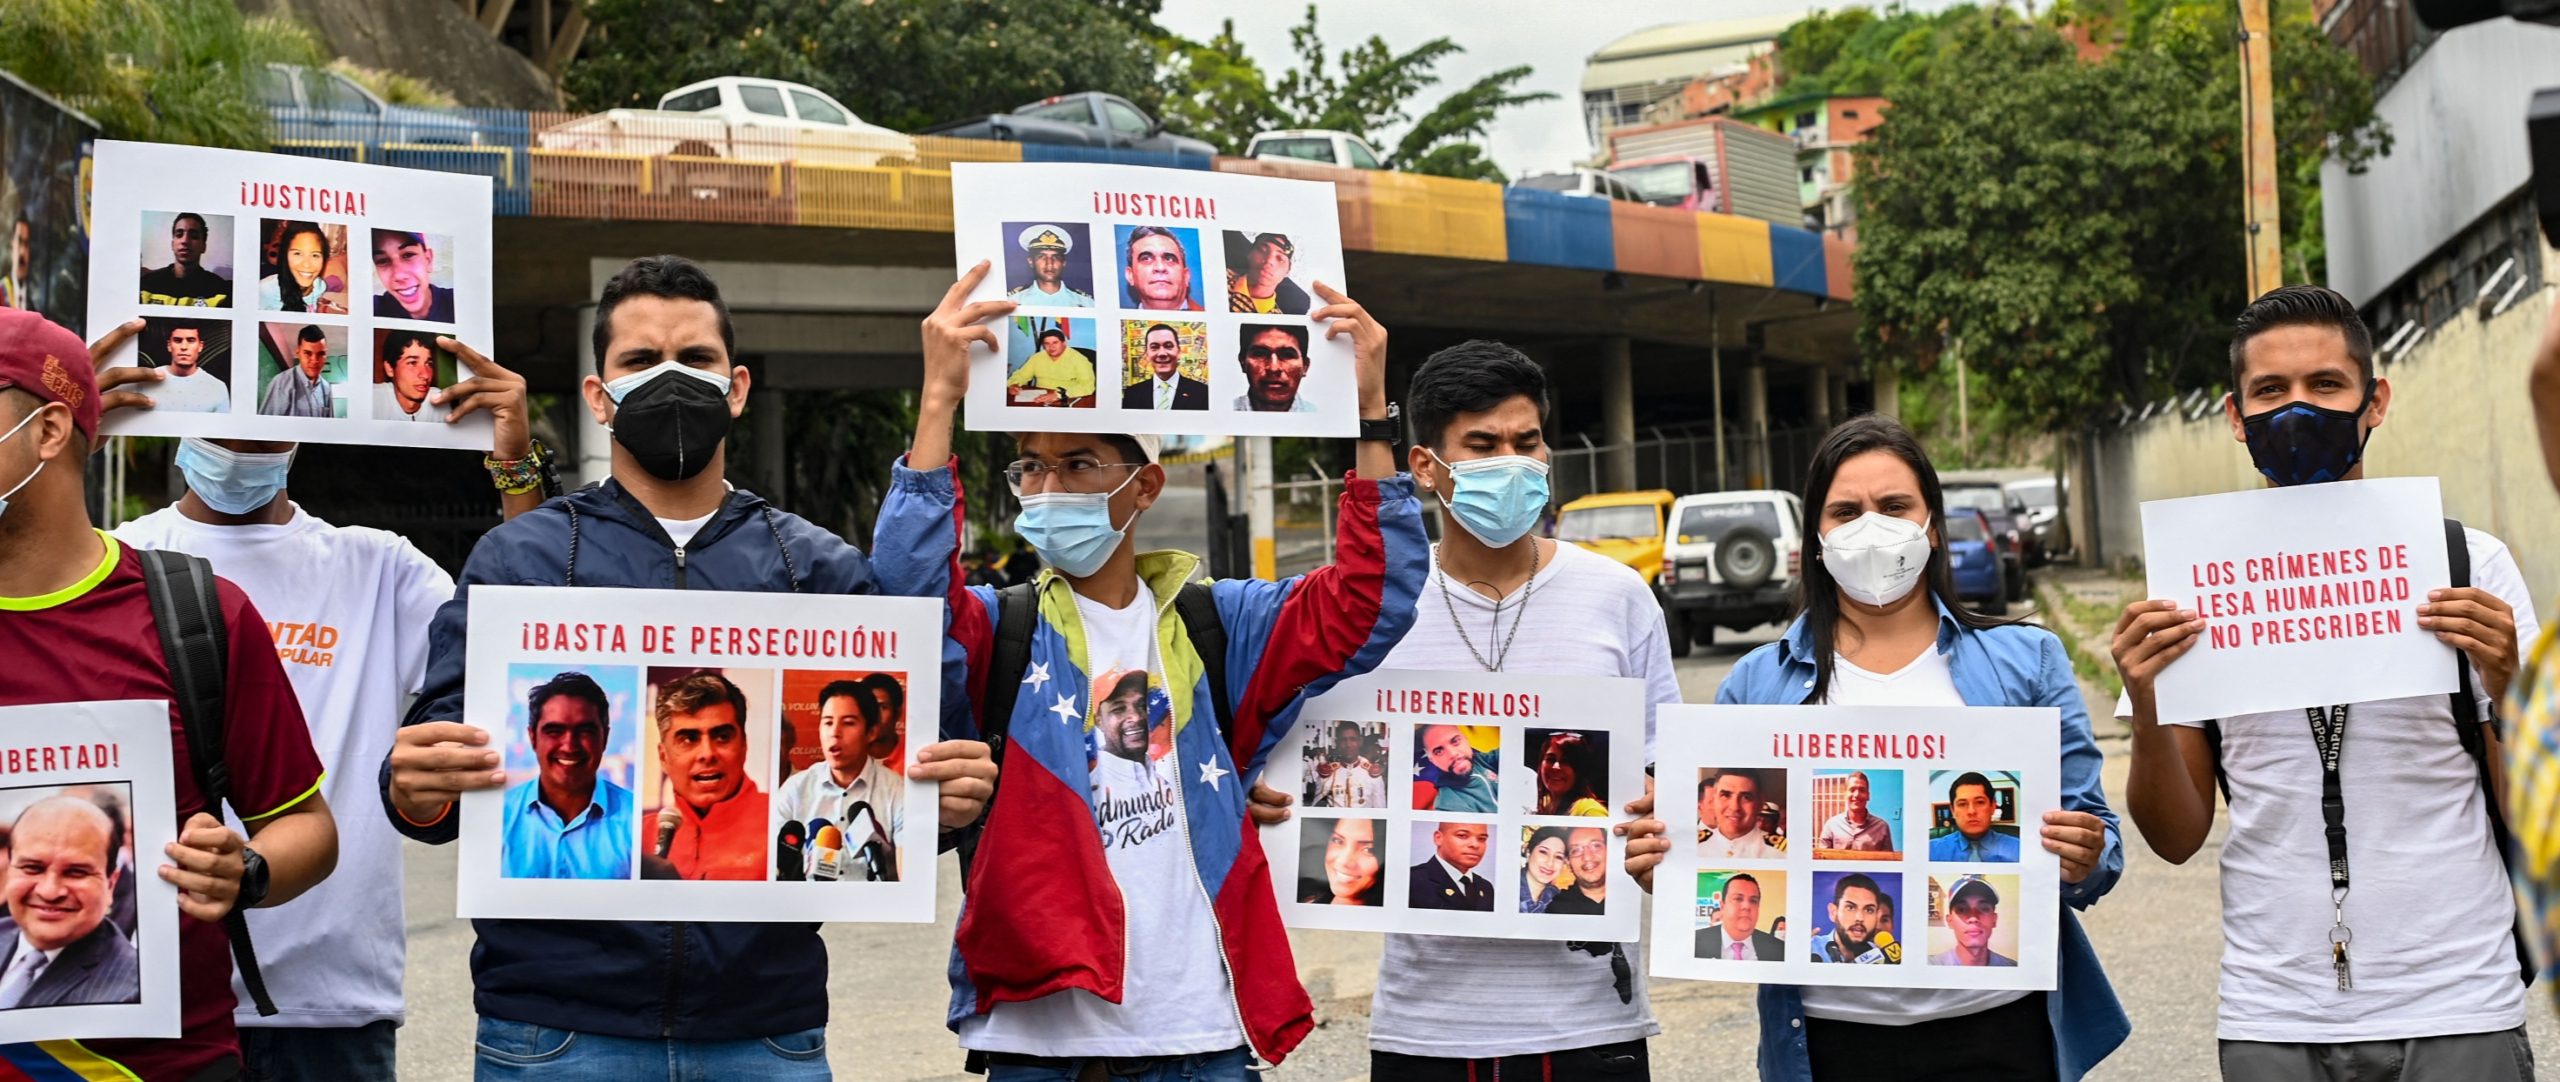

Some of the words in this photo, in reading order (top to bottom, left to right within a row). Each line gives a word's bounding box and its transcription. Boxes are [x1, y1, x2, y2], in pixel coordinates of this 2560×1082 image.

[241, 181, 366, 216] ¡JUSTICIA!
[1093, 191, 1216, 220] ¡JUSTICIA!
[2192, 561, 2236, 588] LOS
[2246, 548, 2368, 583] CRÍMENES
[2378, 544, 2409, 570] DE
[2196, 591, 2256, 619] LESA
[2265, 576, 2410, 613] HUMANIDAD
[522, 622, 627, 653] ¡BASTA
[642, 625, 676, 654] DE
[690, 625, 899, 660] PERSECUCIÓN!
[2210, 624, 2242, 650] NO
[2251, 609, 2402, 646] PRESCRIBEN
[1376, 688, 1541, 718] ¡LIBERENLOS!
[1773, 733, 1945, 759] ¡LIBERENLOS!
[1116, 806, 1175, 849] Rada
